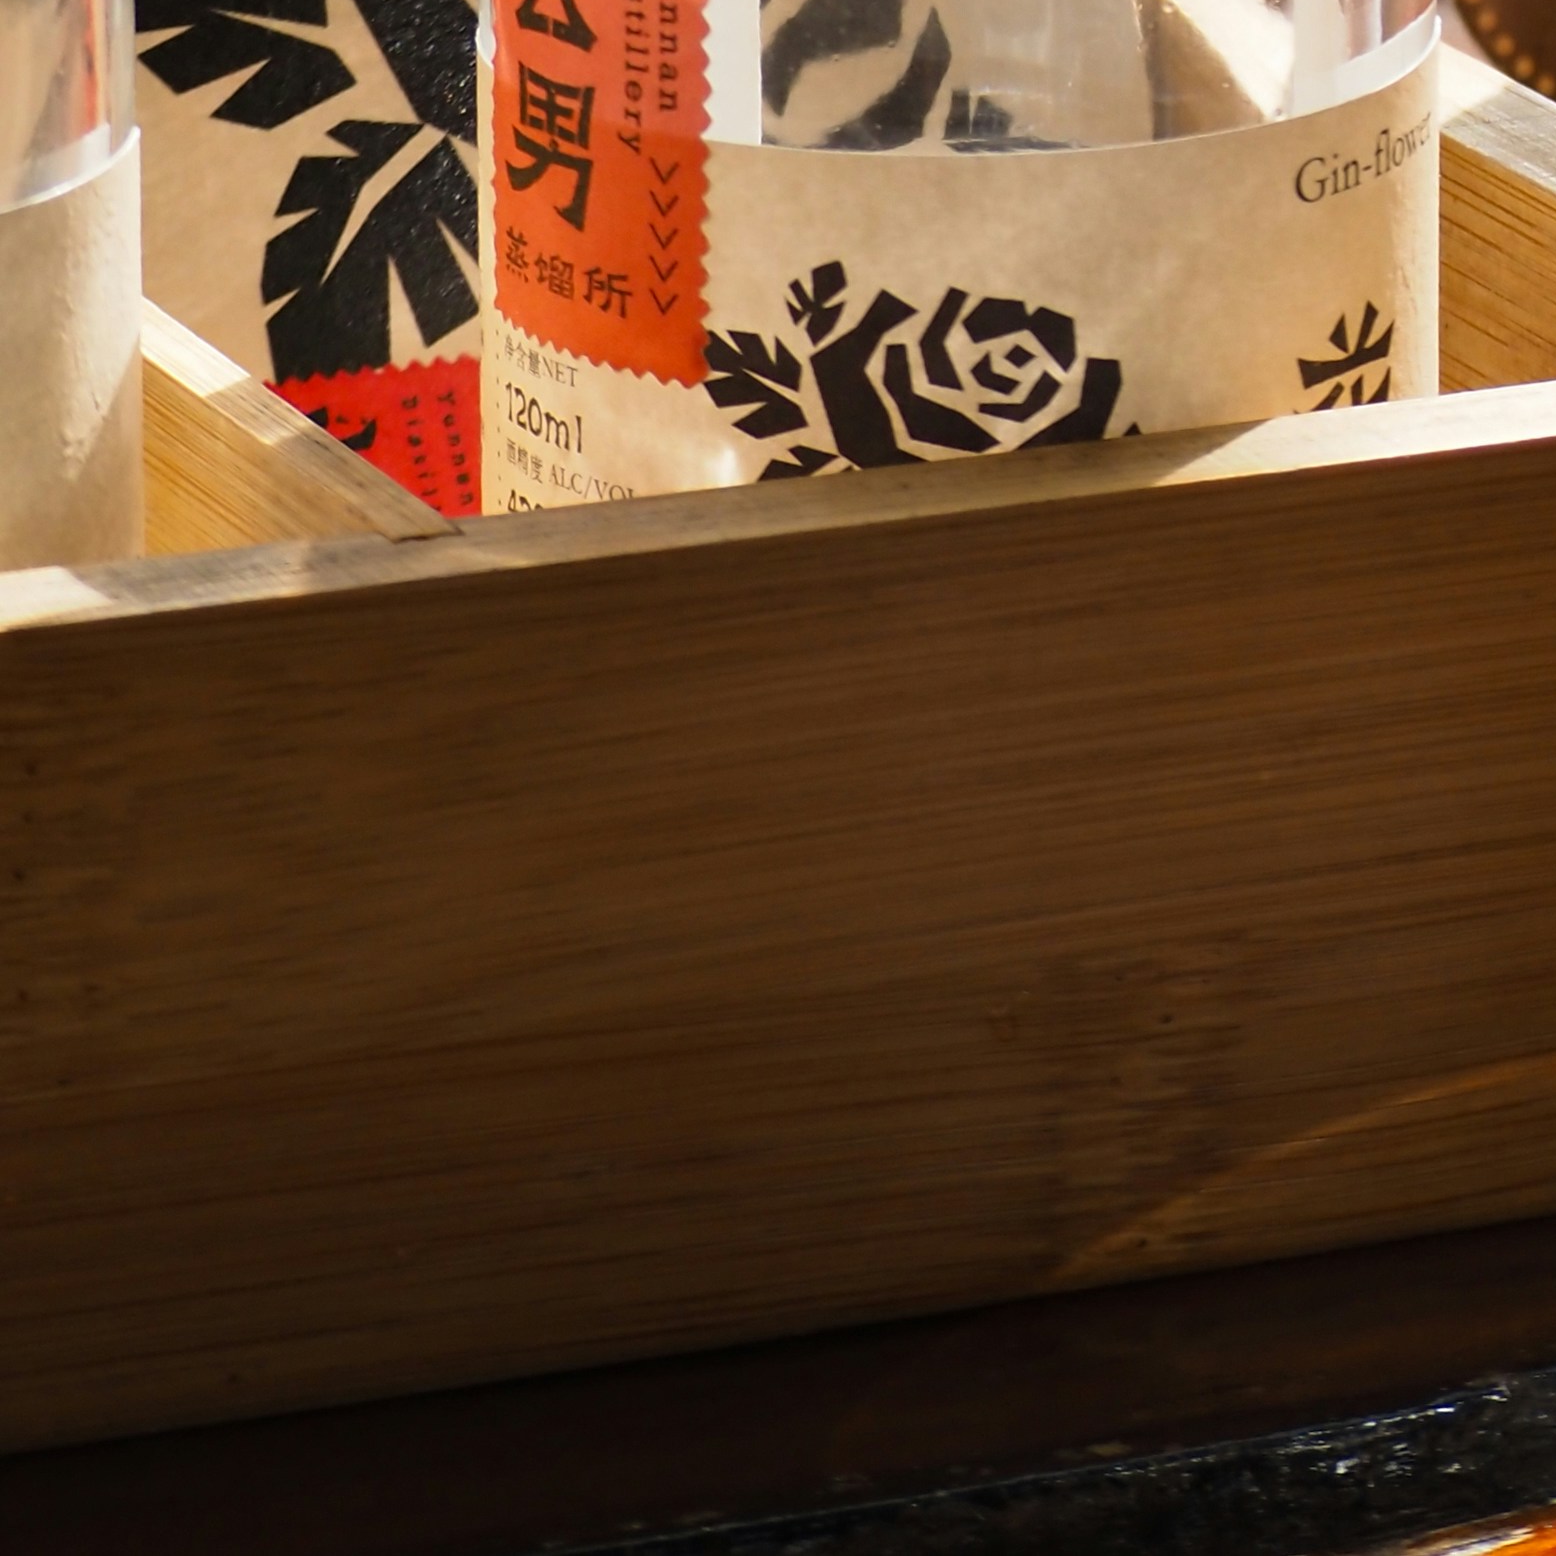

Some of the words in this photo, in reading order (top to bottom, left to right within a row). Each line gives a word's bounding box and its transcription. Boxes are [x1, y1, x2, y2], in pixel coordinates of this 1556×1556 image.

[505, 225, 633, 319] 蒸馏所
[505, 381, 583, 454] 120ml
